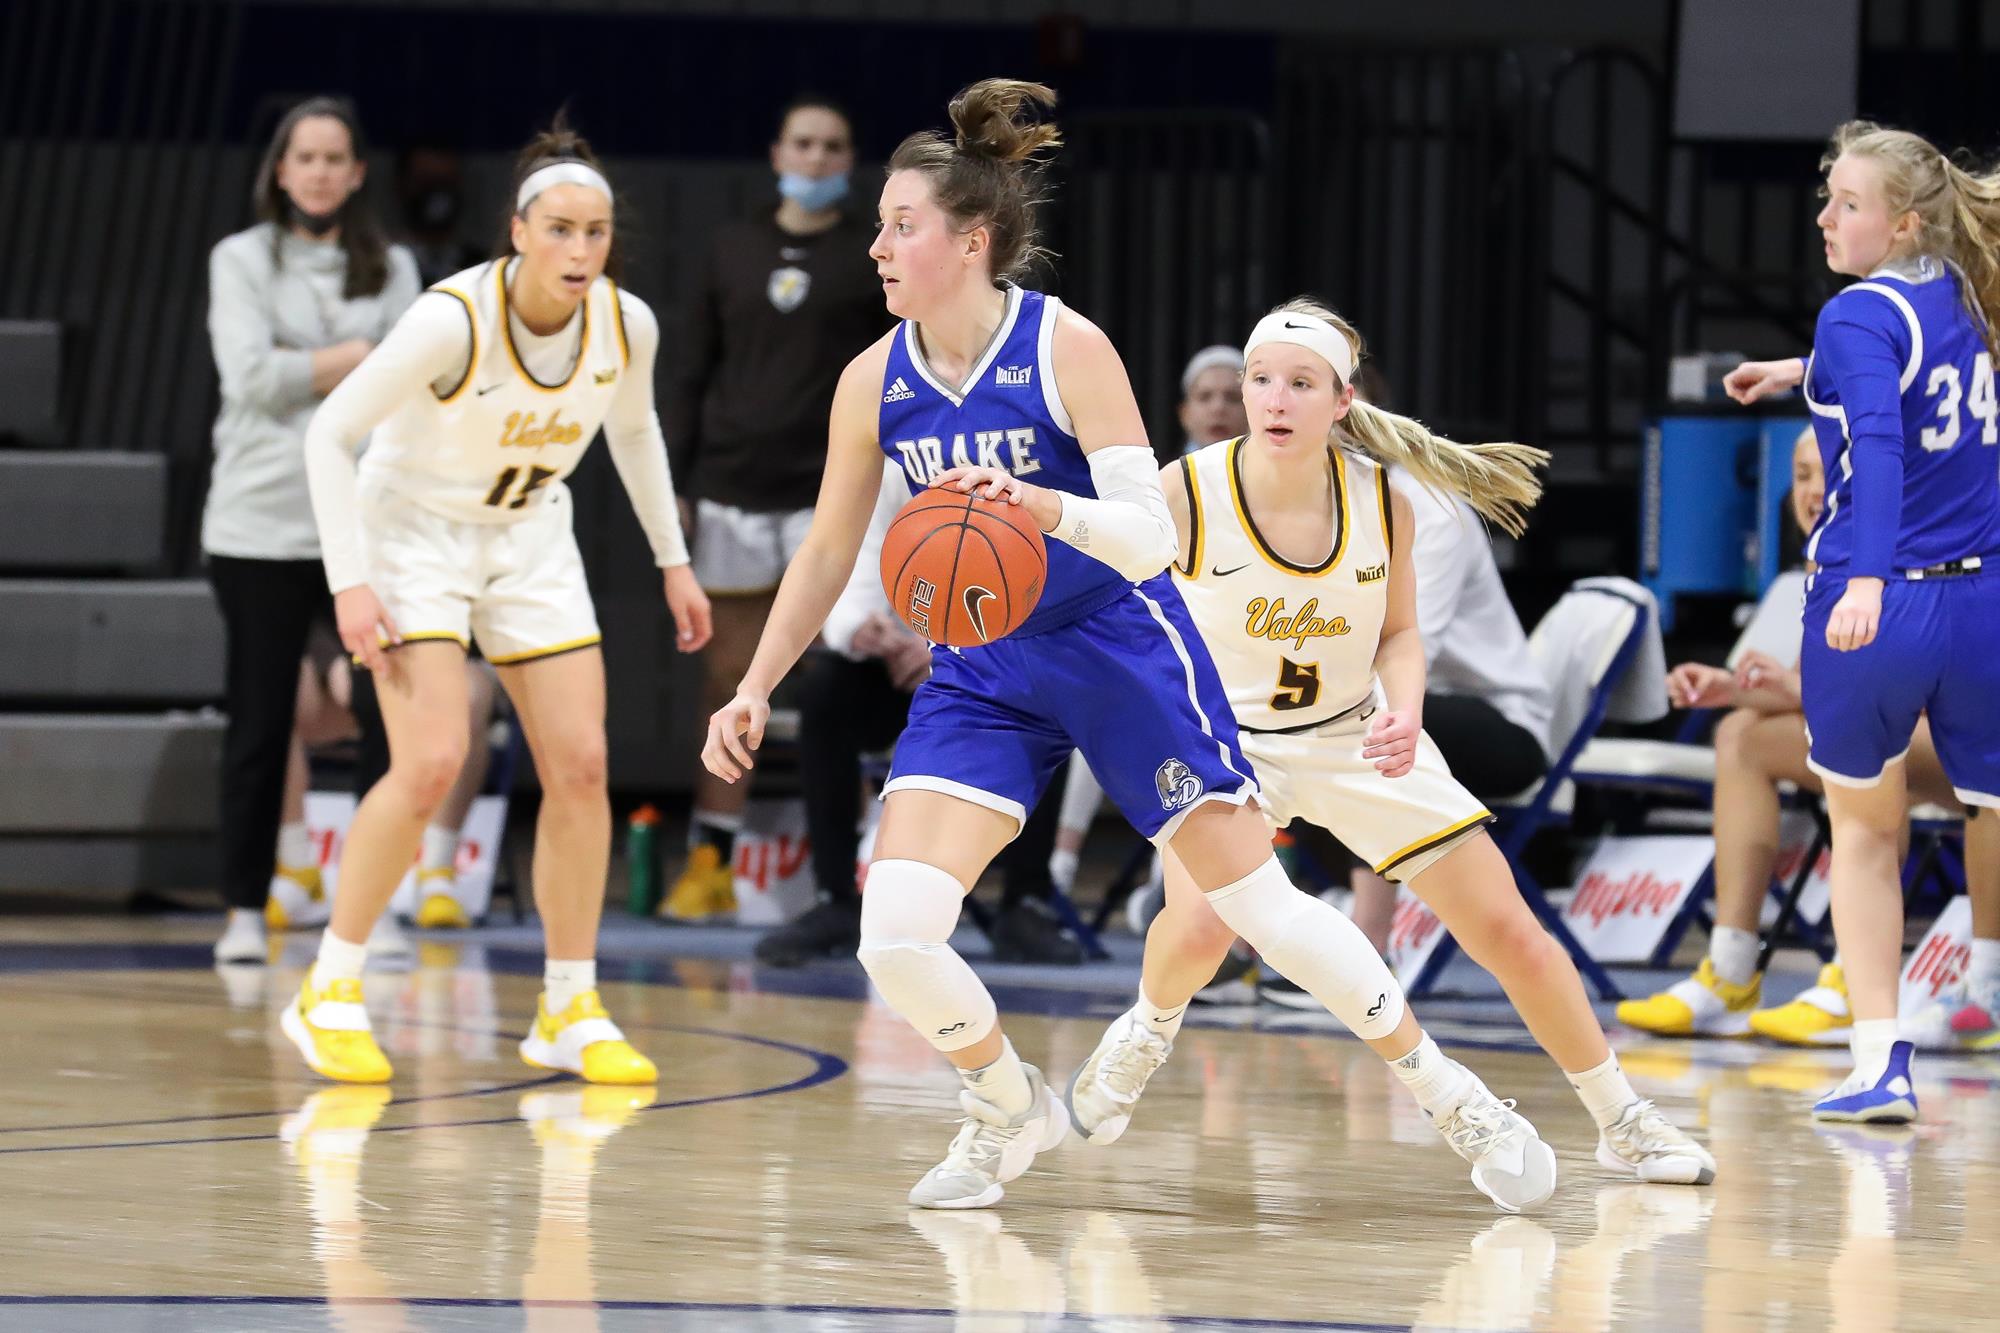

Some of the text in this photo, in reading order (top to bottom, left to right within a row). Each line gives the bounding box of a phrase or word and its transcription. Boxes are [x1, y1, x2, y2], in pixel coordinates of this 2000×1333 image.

[883, 390, 916, 404] adidas
[996, 365, 1033, 384] VALLEY
[1920, 352, 1998, 452] 34
[499, 408, 583, 453] Valpo
[895, 427, 1042, 486] DRAKE
[1355, 561, 1386, 584] VALLEY
[911, 577, 937, 638] ELITE
[1245, 596, 1351, 651] Valpo
[1267, 655, 1322, 711] 5
